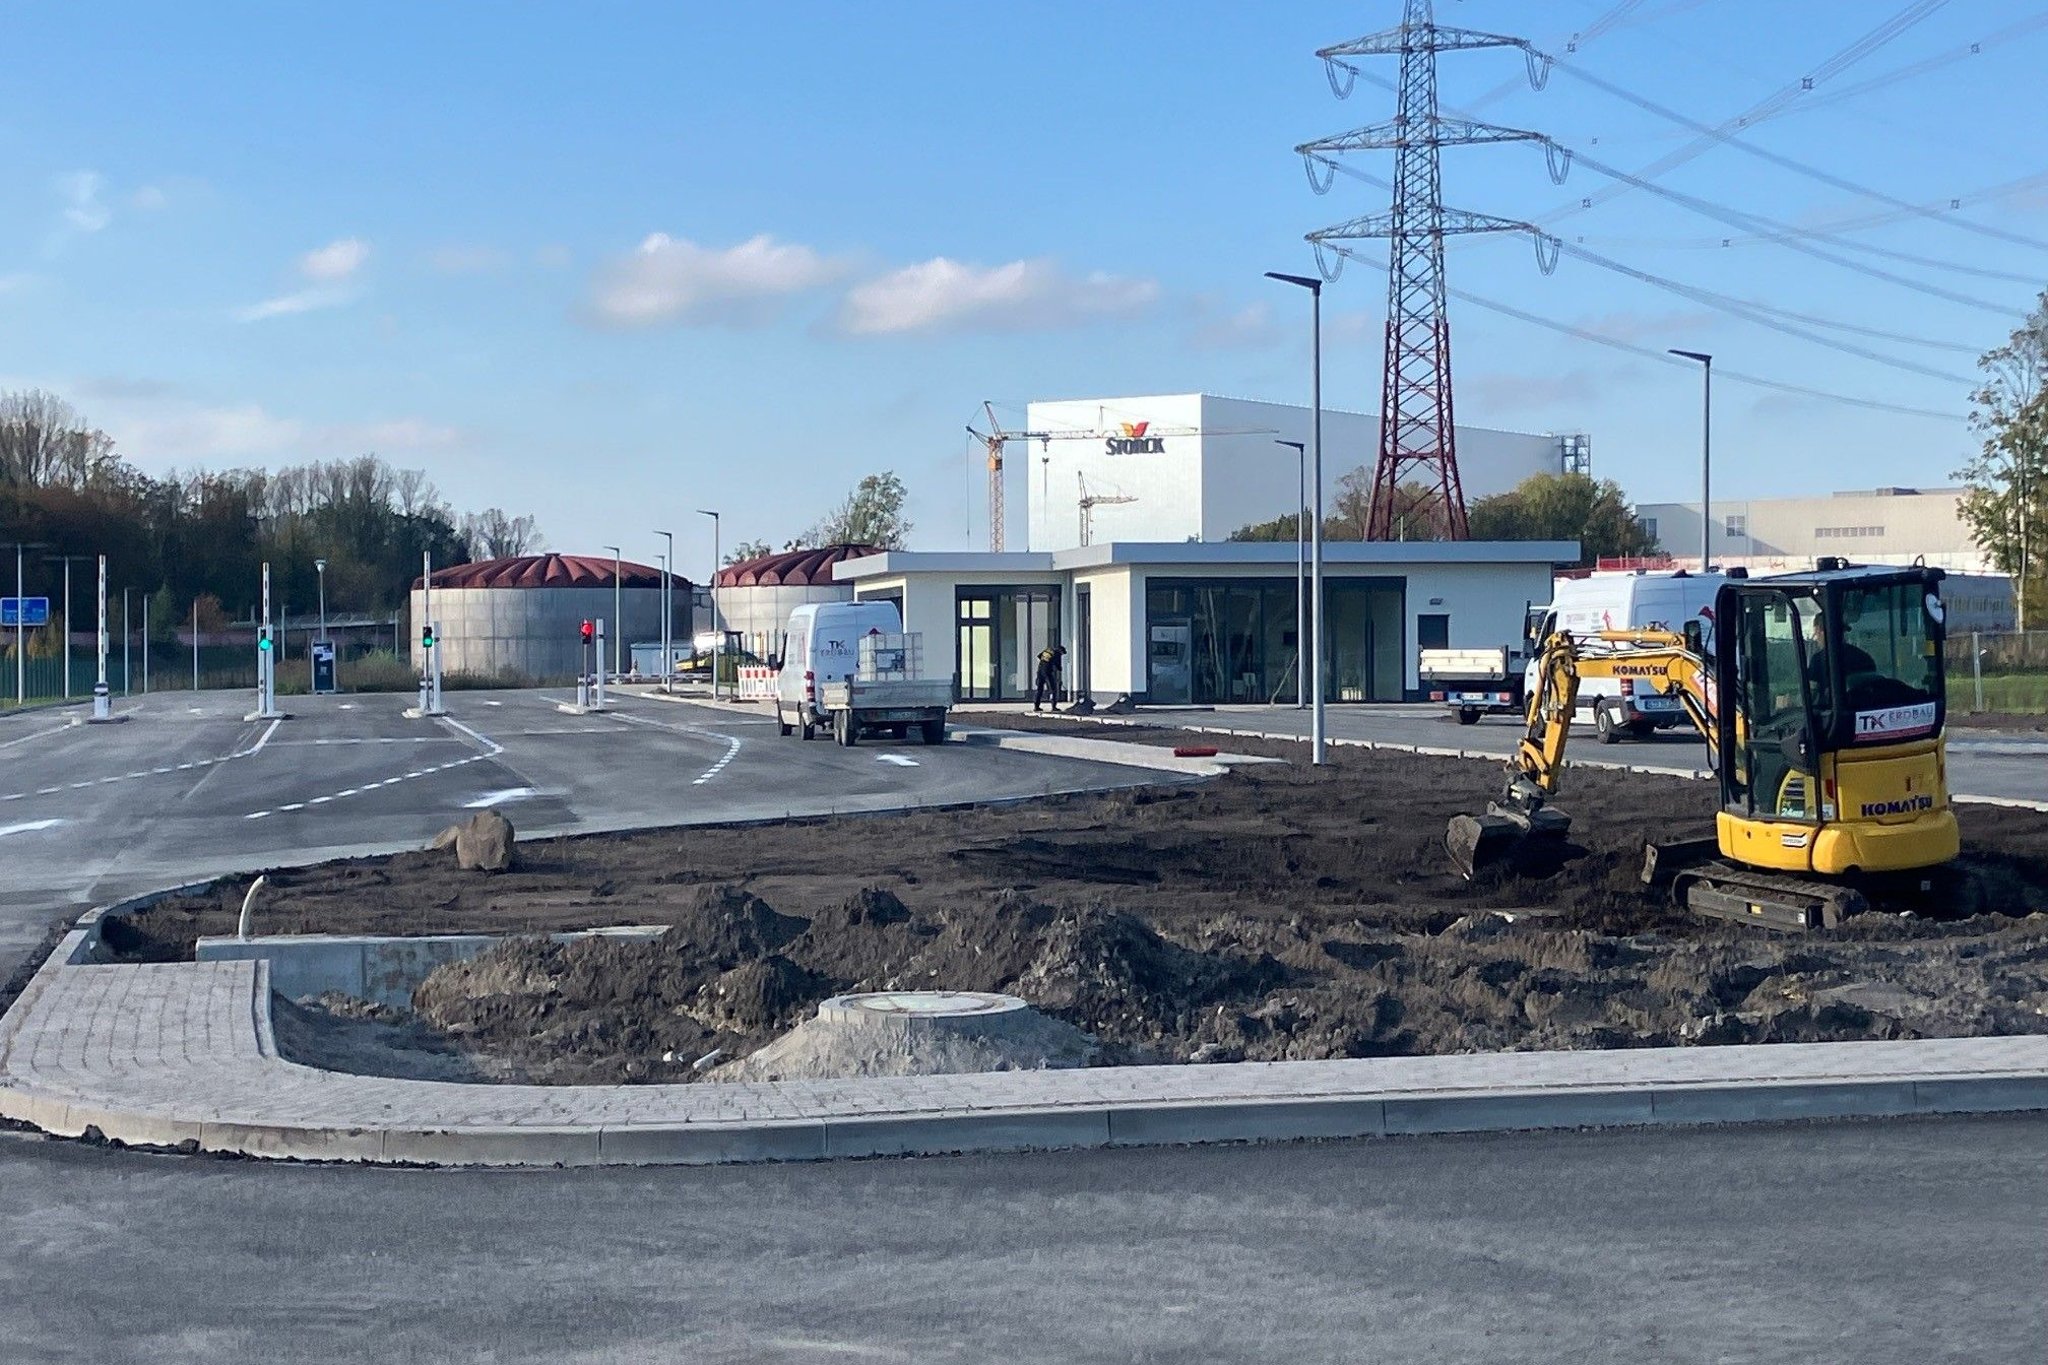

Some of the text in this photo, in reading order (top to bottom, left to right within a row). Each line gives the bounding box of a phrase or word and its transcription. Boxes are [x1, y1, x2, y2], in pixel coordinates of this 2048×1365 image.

[828, 640, 845, 649] TK
[1612, 665, 1667, 675] KOMATSU
[1859, 714, 1885, 731] TK
[1861, 795, 1932, 816] KOMATSU
